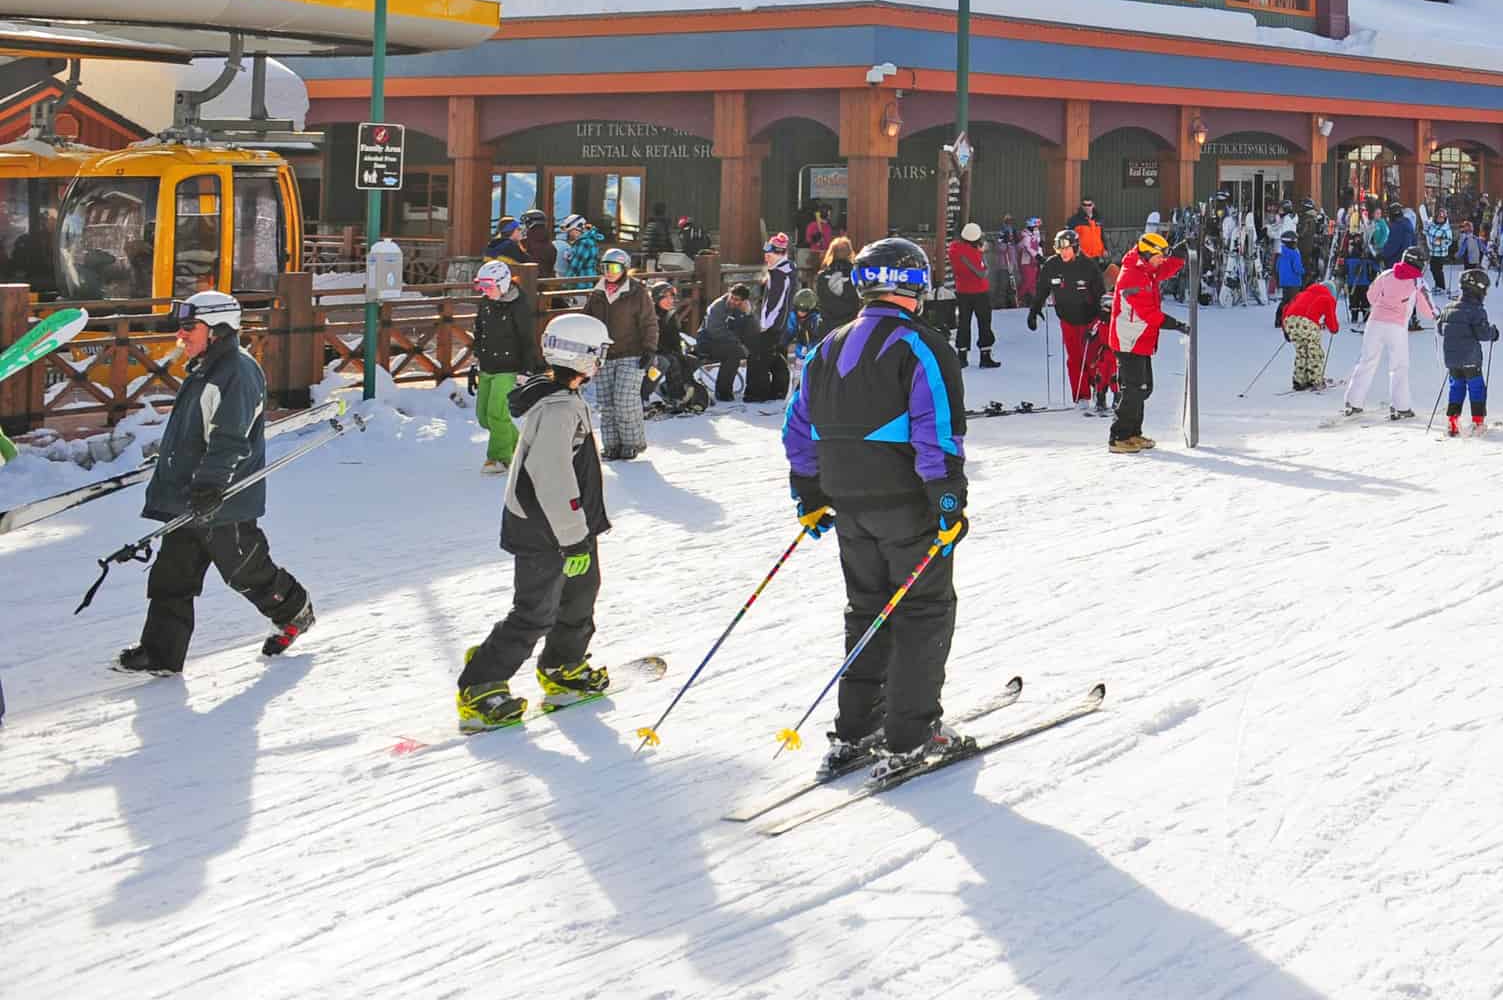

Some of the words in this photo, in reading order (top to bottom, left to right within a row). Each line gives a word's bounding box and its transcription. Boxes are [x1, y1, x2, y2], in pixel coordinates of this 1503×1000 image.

[576, 122, 602, 137] LIFT
[607, 122, 659, 137] TICKETS
[582, 144, 628, 159] RENTAL
[631, 145, 641, 159] &
[645, 144, 690, 159] RETAIL
[888, 164, 927, 180] TAIRS
